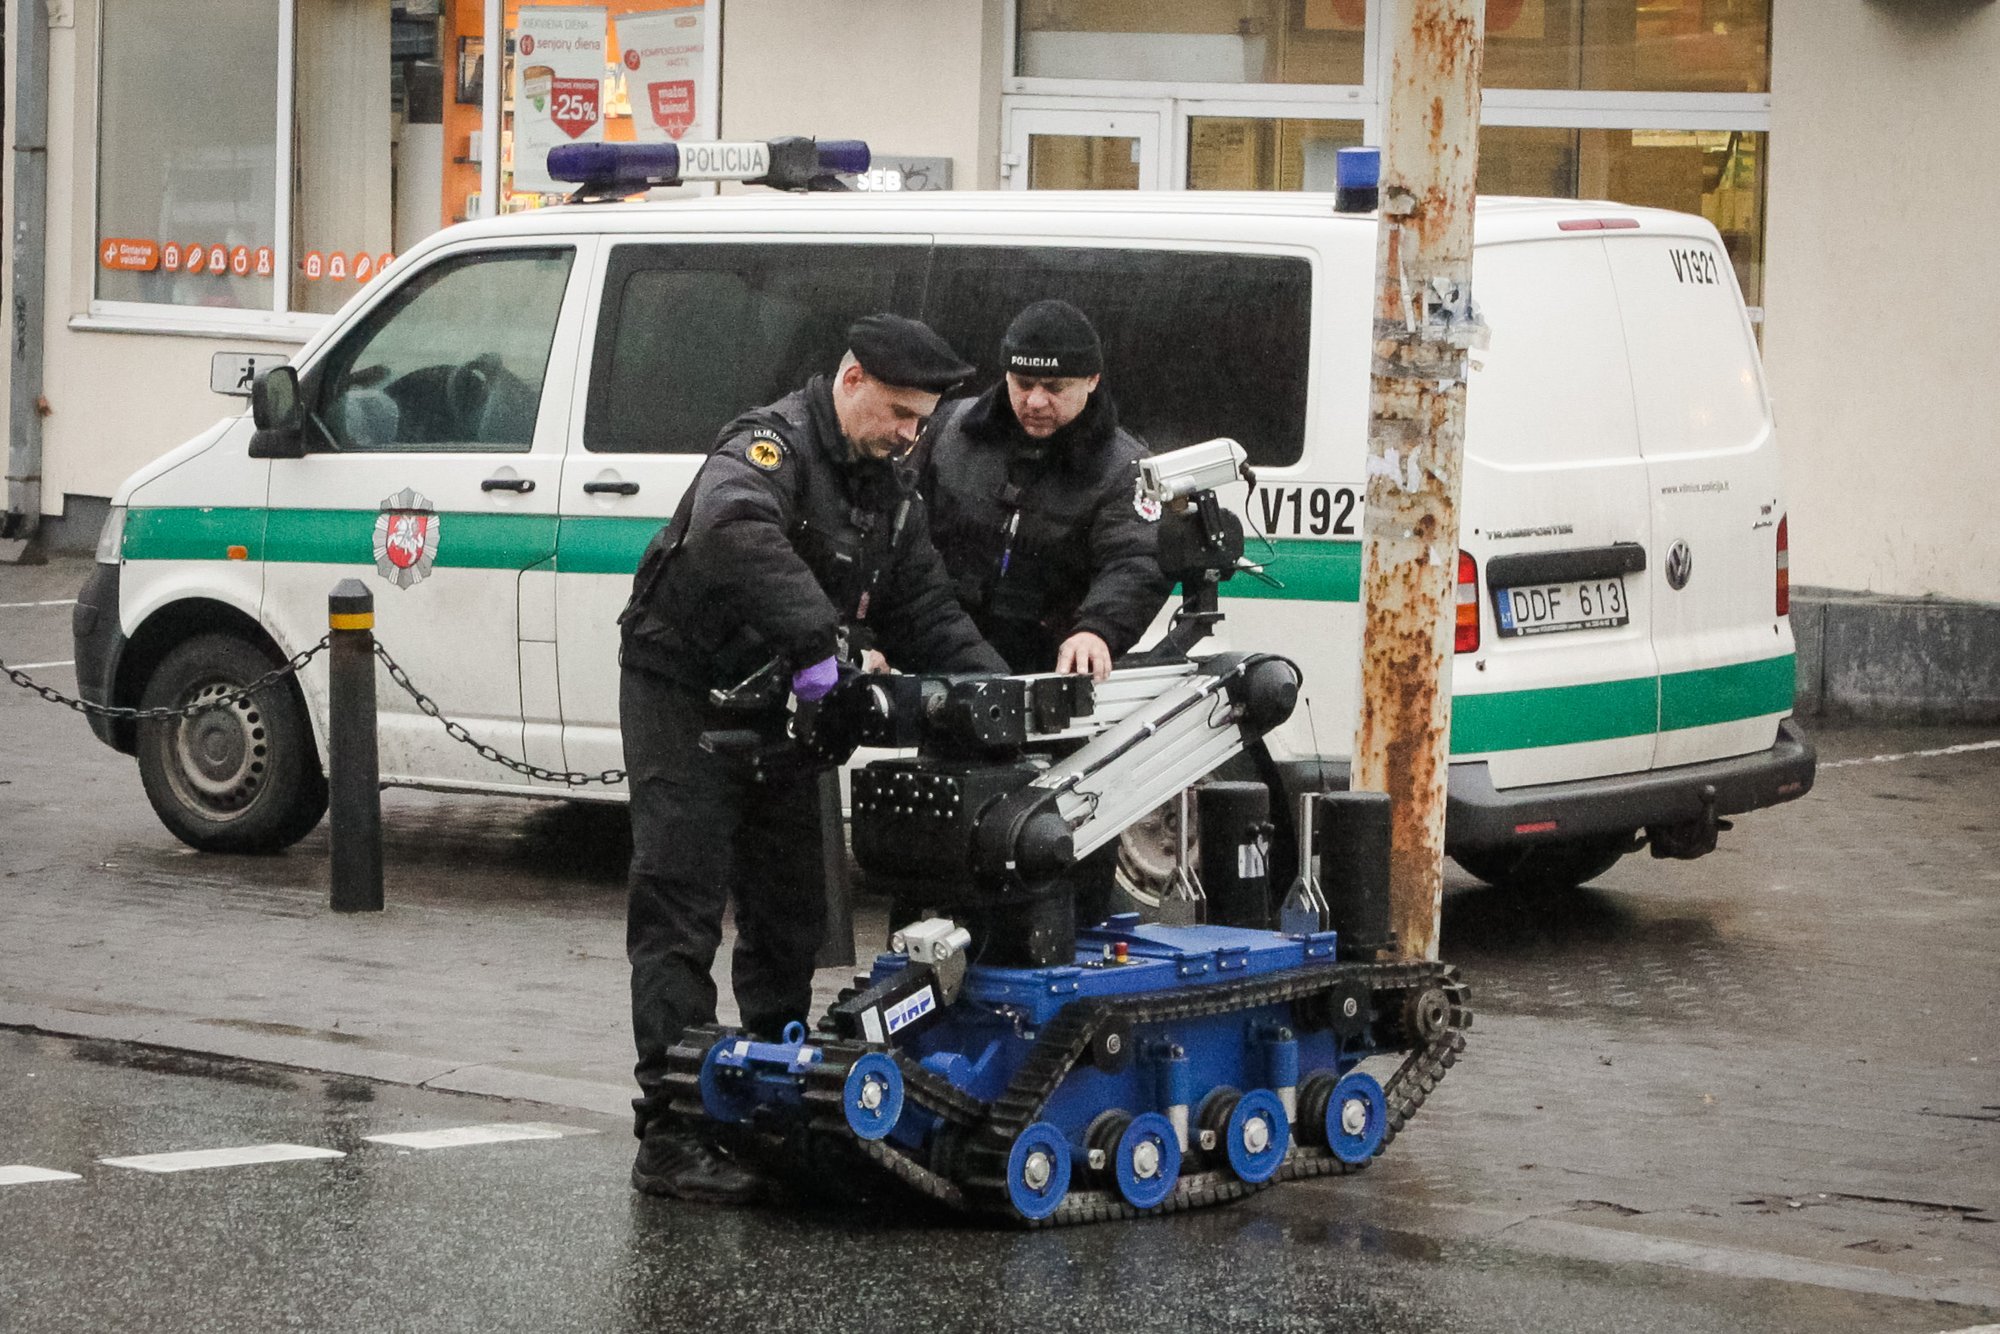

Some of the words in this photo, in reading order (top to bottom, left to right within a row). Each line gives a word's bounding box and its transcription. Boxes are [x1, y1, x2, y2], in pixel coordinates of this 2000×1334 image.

[574, 36, 600, 50] diena
[552, 94, 597, 121] -25%
[686, 147, 765, 173] POLICIJA
[857, 169, 902, 192] SEB
[1668, 248, 1720, 285] V1921
[1011, 355, 1059, 367] POLICIJA
[1260, 487, 1365, 535] V192
[1512, 587, 1561, 622] DDF
[1579, 582, 1621, 616] 613
